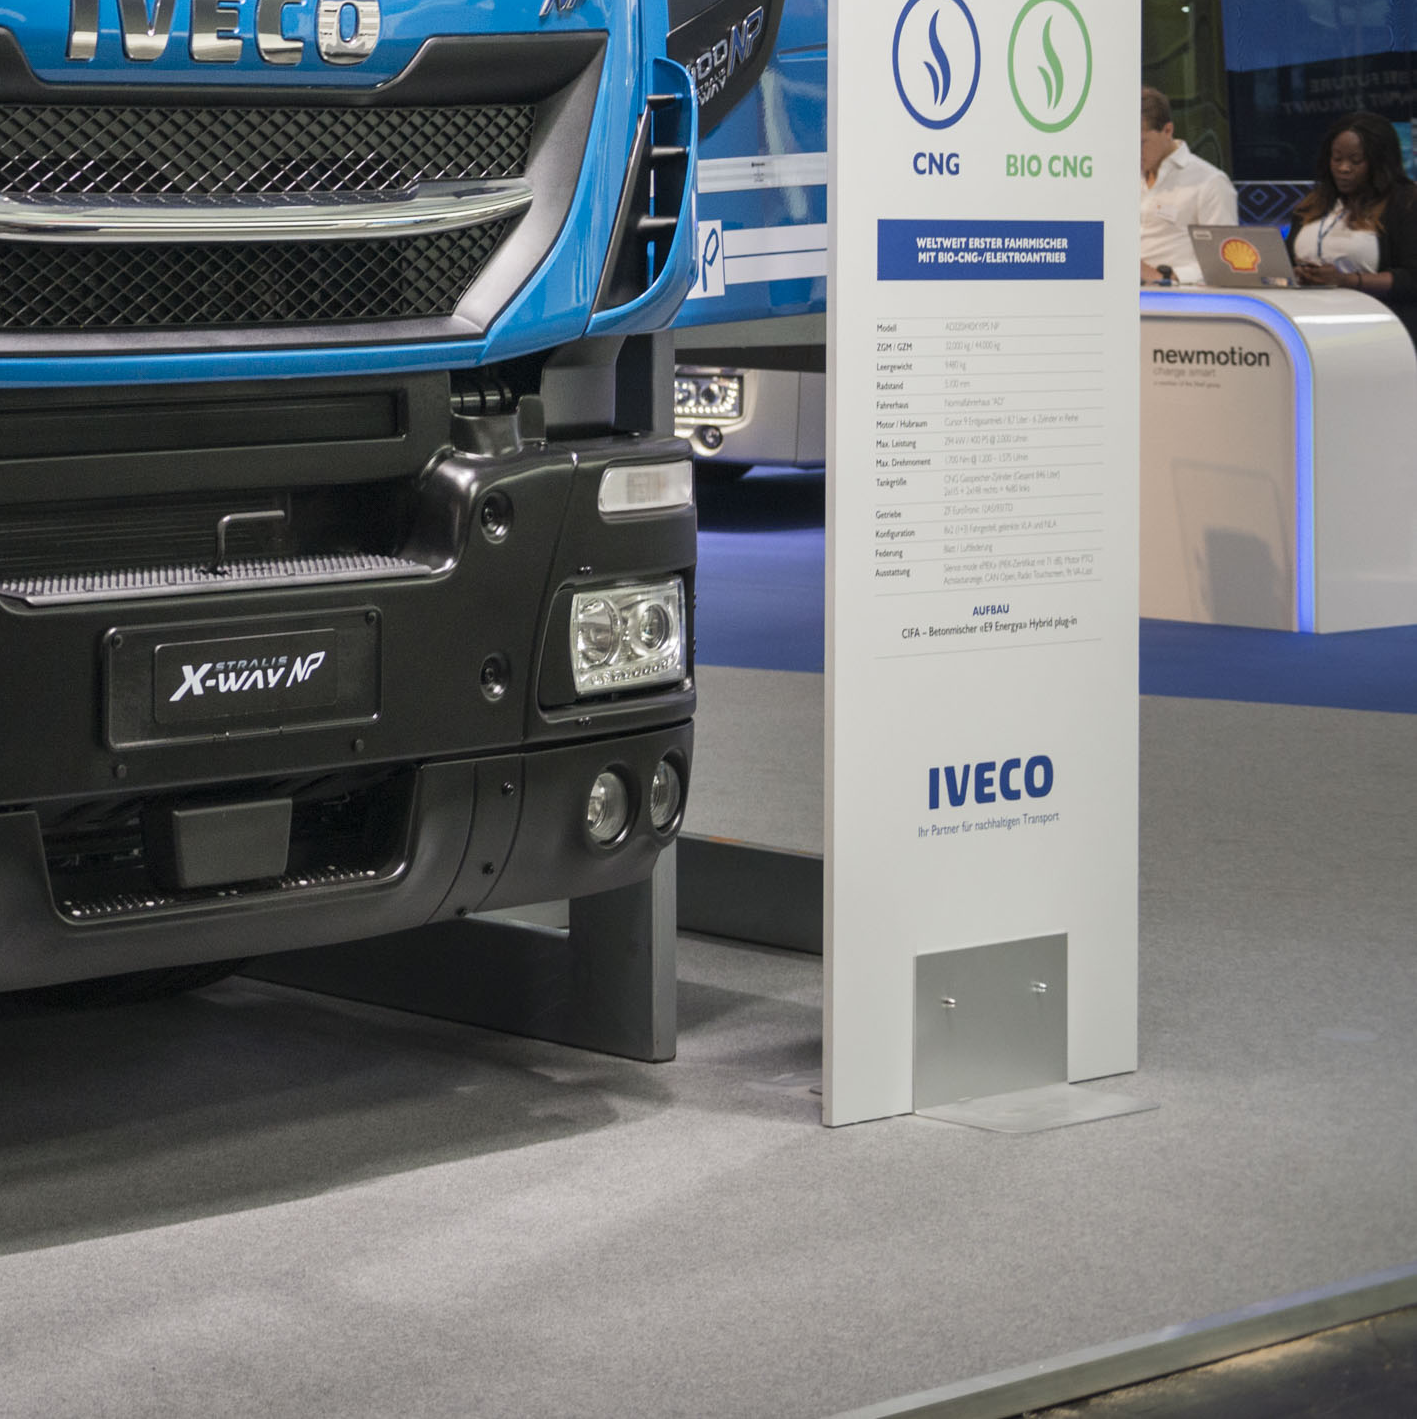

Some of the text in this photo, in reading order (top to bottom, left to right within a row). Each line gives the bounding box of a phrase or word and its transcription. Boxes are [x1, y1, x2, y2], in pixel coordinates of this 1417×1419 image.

[727, 6, 764, 79] NP
[913, 152, 960, 175] CNG
[1006, 154, 1093, 178] BIO CNG
[917, 237, 1069, 250] WELTWEIT ERSTER FAHRMISCHER
[918, 251, 936, 263] MIT
[876, 324, 897, 333] Modell
[876, 342, 892, 352] ZGM
[897, 342, 913, 352] GZM
[1153, 346, 1270, 367] newmotion
[876, 362, 913, 373] Leergewicht
[876, 381, 904, 390] Radstand
[876, 400, 909, 410] Fahrerhaus
[876, 420, 894, 429] Motor
[900, 419, 928, 428] Hubraum
[876, 439, 917, 450] Max. Leistung
[876, 457, 931, 468] Max. Drehmoment
[875, 510, 902, 520] Getriebe
[875, 528, 916, 539] Konfiguration
[875, 549, 903, 559] Federung
[875, 567, 911, 578] Ausstattung
[972, 604, 1010, 617] AUFBAU
[901, 628, 921, 639] CIFA
[928, 623, 977, 638] Betonmischer
[1028, 617, 1053, 631] Hybrid
[1054, 615, 1078, 630] plug-in
[215, 651, 326, 688] STRALIS NP
[169, 663, 286, 702] X-WAY
[928, 755, 1054, 810] IVECO
[918, 812, 1060, 838] Ihr Partner für nachhaltigen Transport
